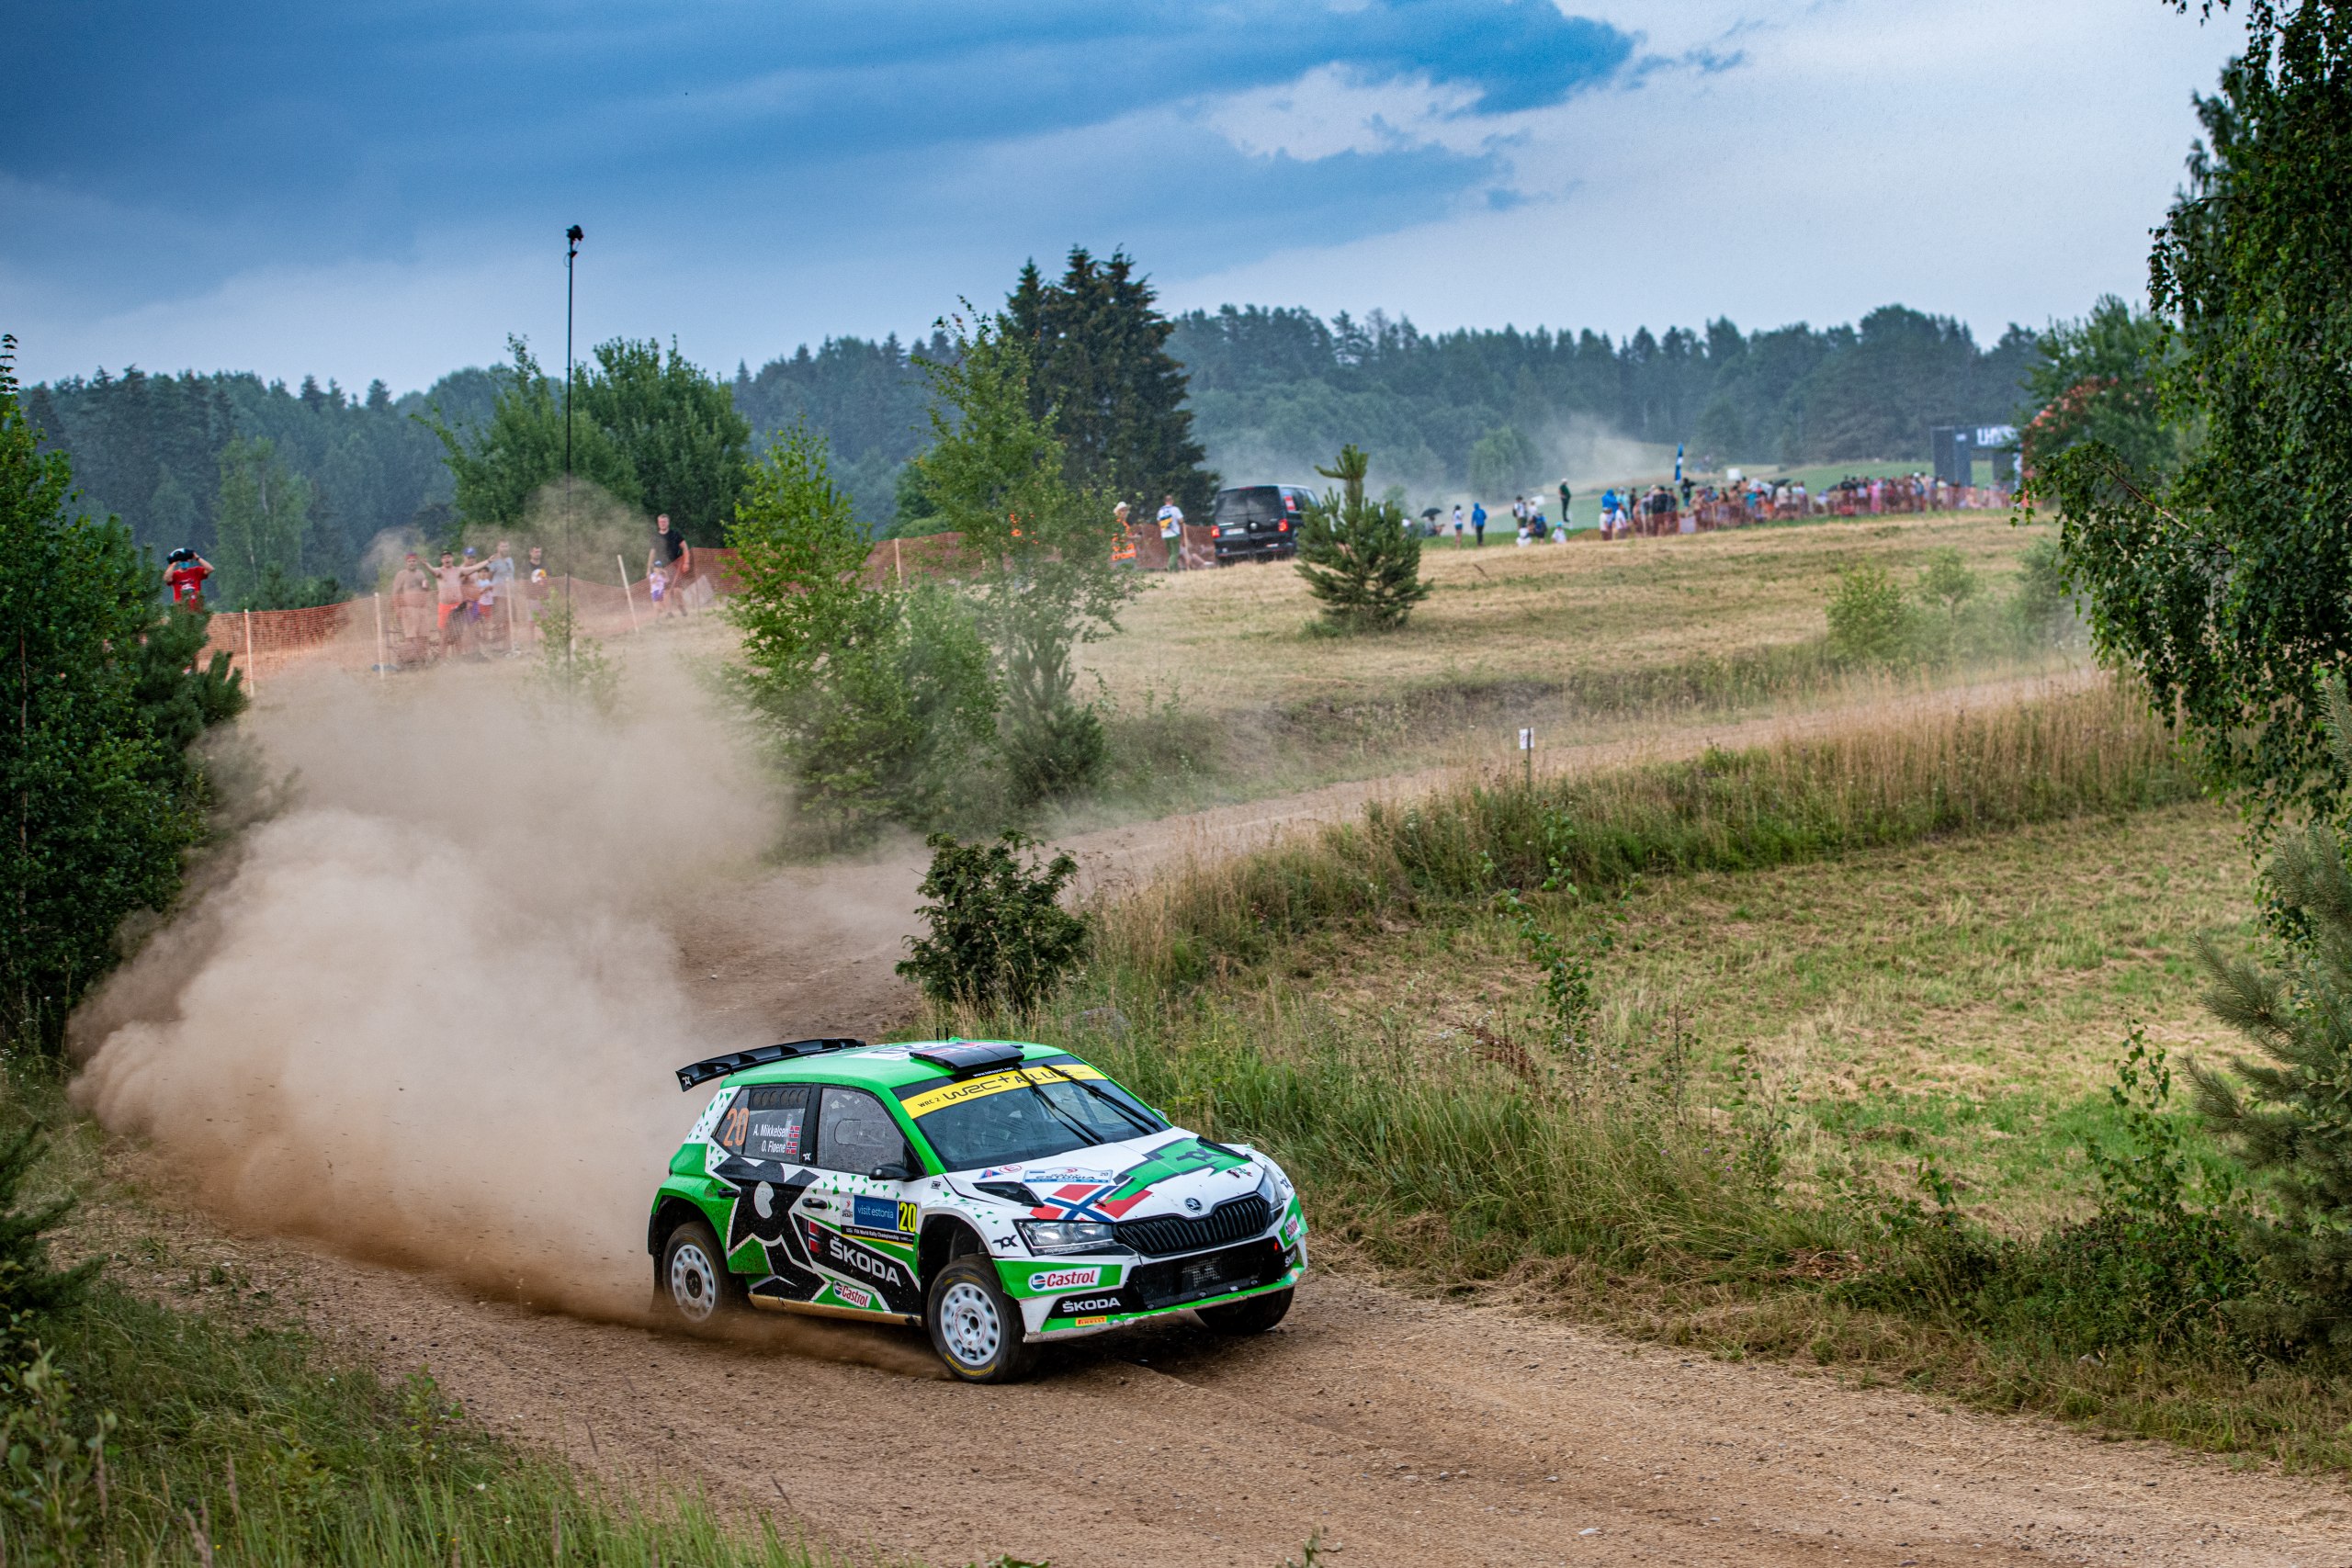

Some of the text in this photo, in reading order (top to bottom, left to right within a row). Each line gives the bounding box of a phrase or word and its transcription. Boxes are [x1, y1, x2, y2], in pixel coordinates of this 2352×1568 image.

[918, 1100, 934, 1108] WRC
[723, 1108, 750, 1146] 20
[753, 1124, 789, 1137] A. Mikkelsen
[761, 1140, 767, 1152] O.
[857, 1205, 871, 1215] visit
[871, 1208, 894, 1219] estonia
[899, 1201, 917, 1233] 20
[877, 1232, 899, 1241] Championship
[830, 1235, 901, 1287] ŠKODA
[1046, 1270, 1095, 1288] Castrol
[842, 1285, 868, 1307] Castrol
[1062, 1297, 1121, 1313] ŠKODA
